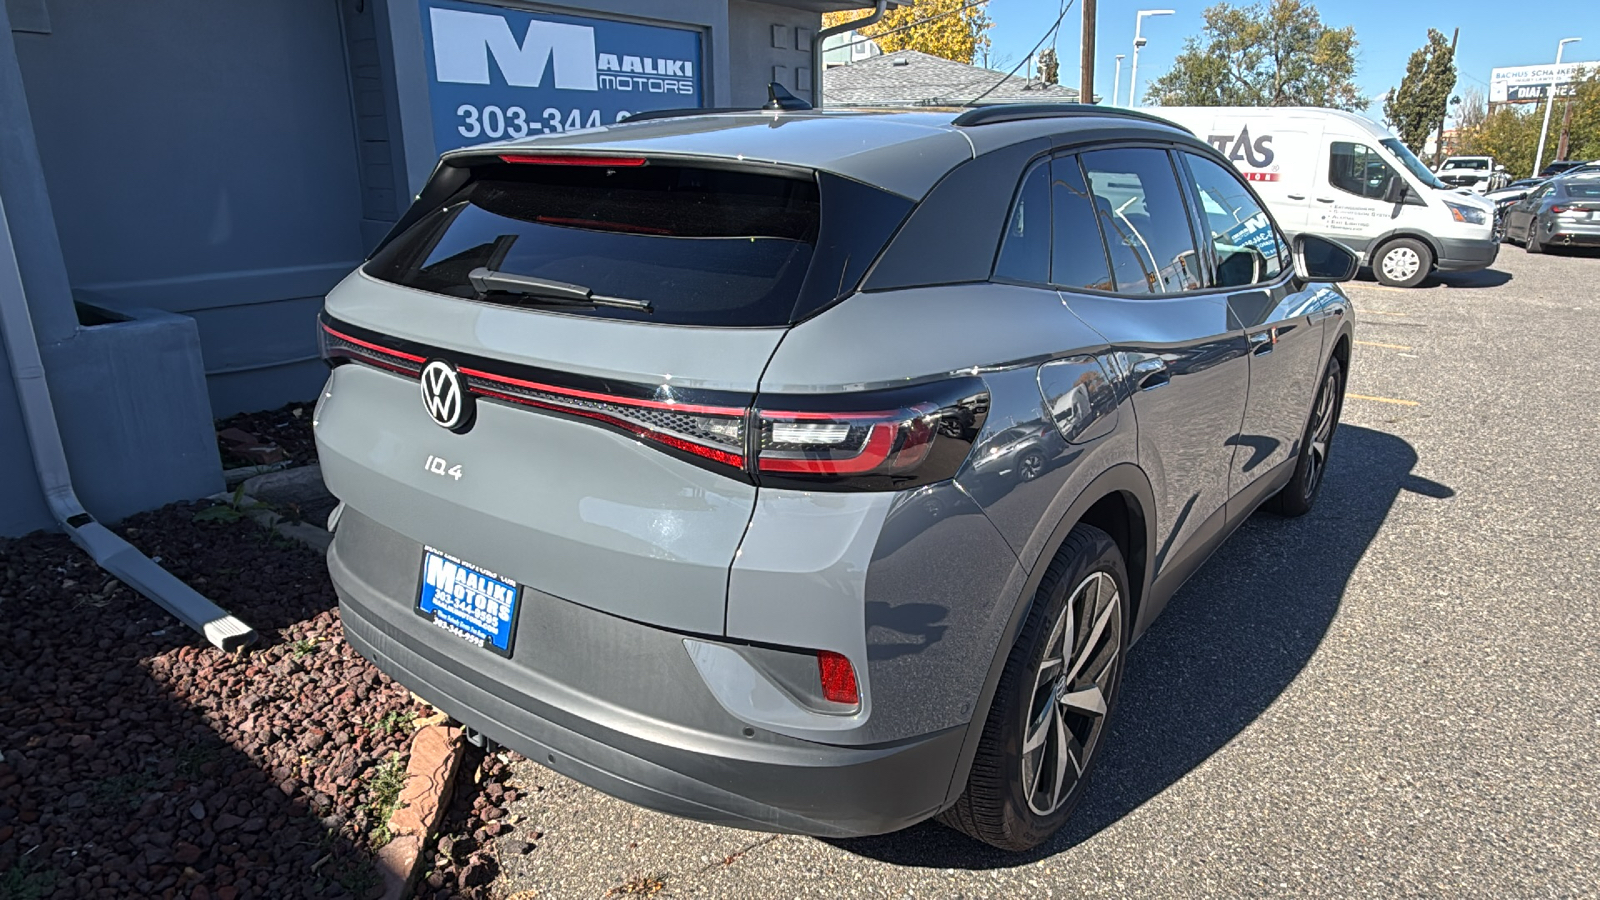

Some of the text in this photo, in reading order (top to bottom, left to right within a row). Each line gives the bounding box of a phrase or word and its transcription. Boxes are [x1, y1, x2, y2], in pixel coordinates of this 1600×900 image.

[1495, 70, 1529, 79] BACHUS
[599, 75, 694, 95] MOTORS
[1207, 123, 1275, 169] TAS
